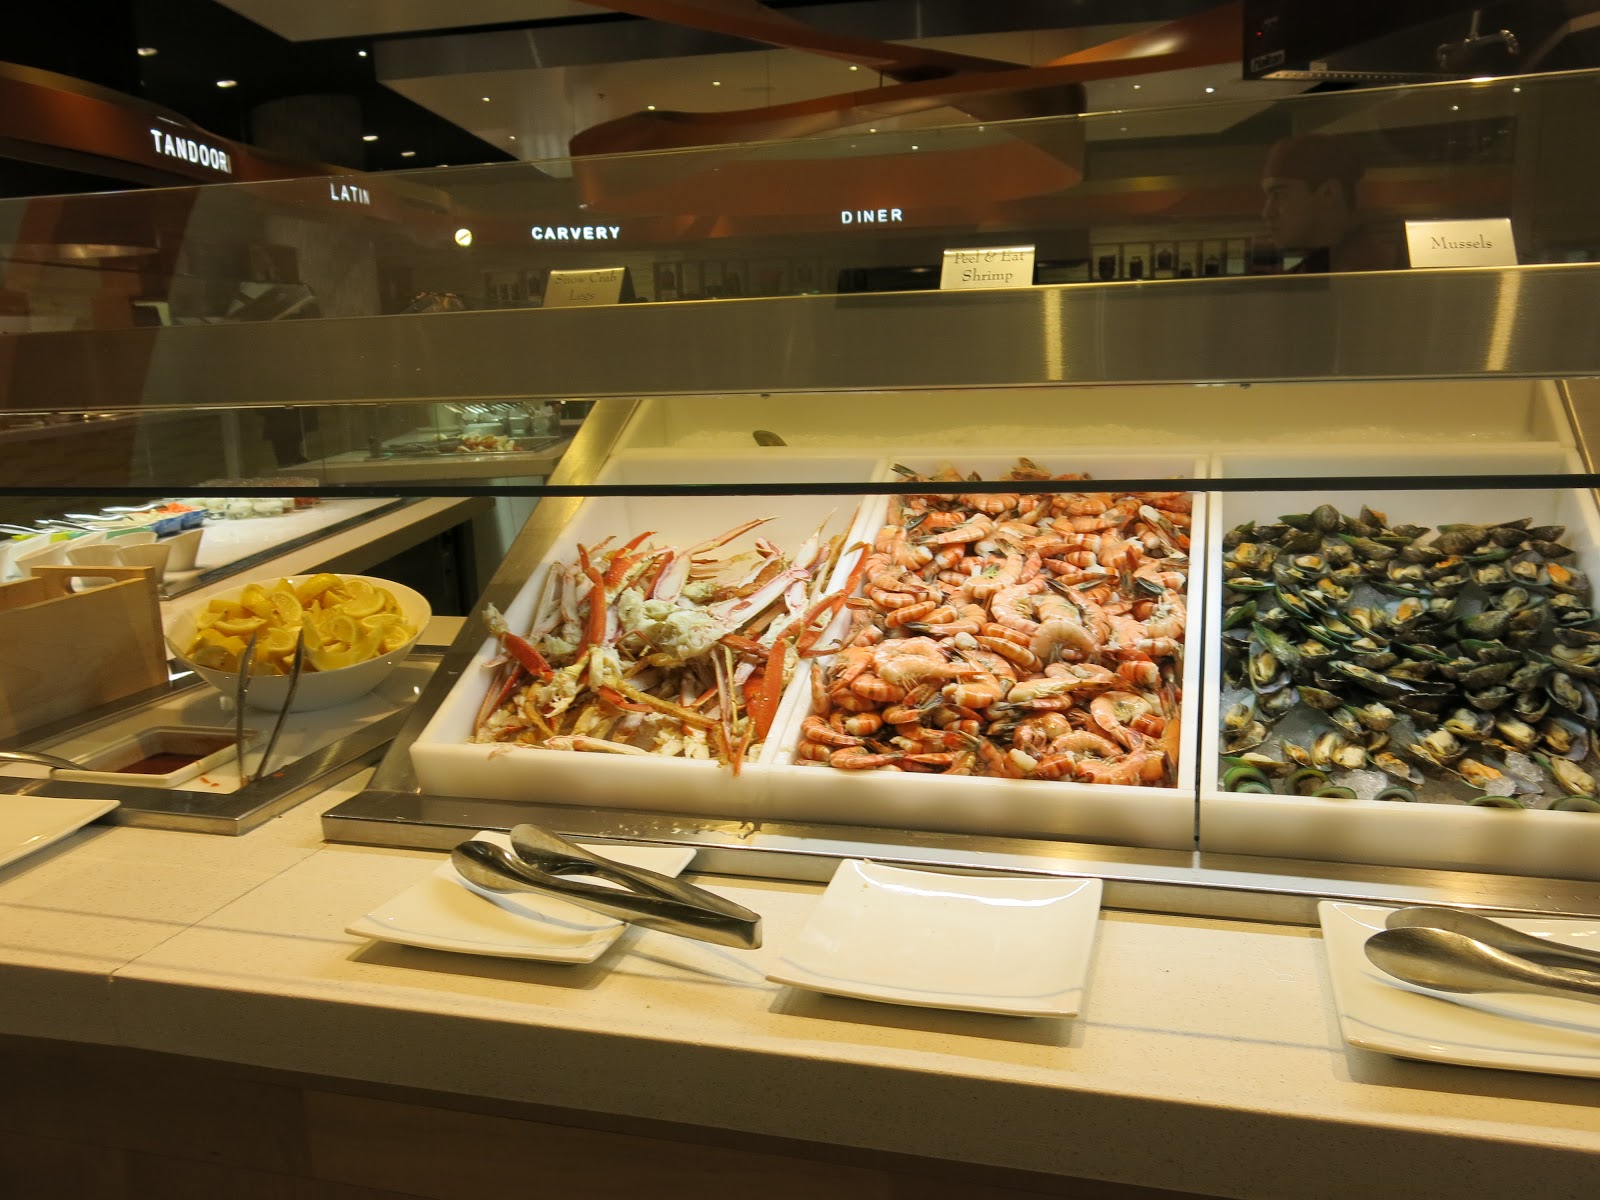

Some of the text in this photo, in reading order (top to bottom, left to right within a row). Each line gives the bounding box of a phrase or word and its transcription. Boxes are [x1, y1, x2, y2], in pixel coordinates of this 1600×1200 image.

[150, 129, 232, 174] TANDOORI
[329, 182, 370, 205] LATIN
[841, 208, 903, 224] DINER
[531, 226, 620, 240] CARVERY
[1430, 234, 1493, 249] Mussels
[954, 250, 1025, 264] Peel & Eat
[589, 270, 617, 283] Crab
[961, 268, 1013, 283] Shrimp
